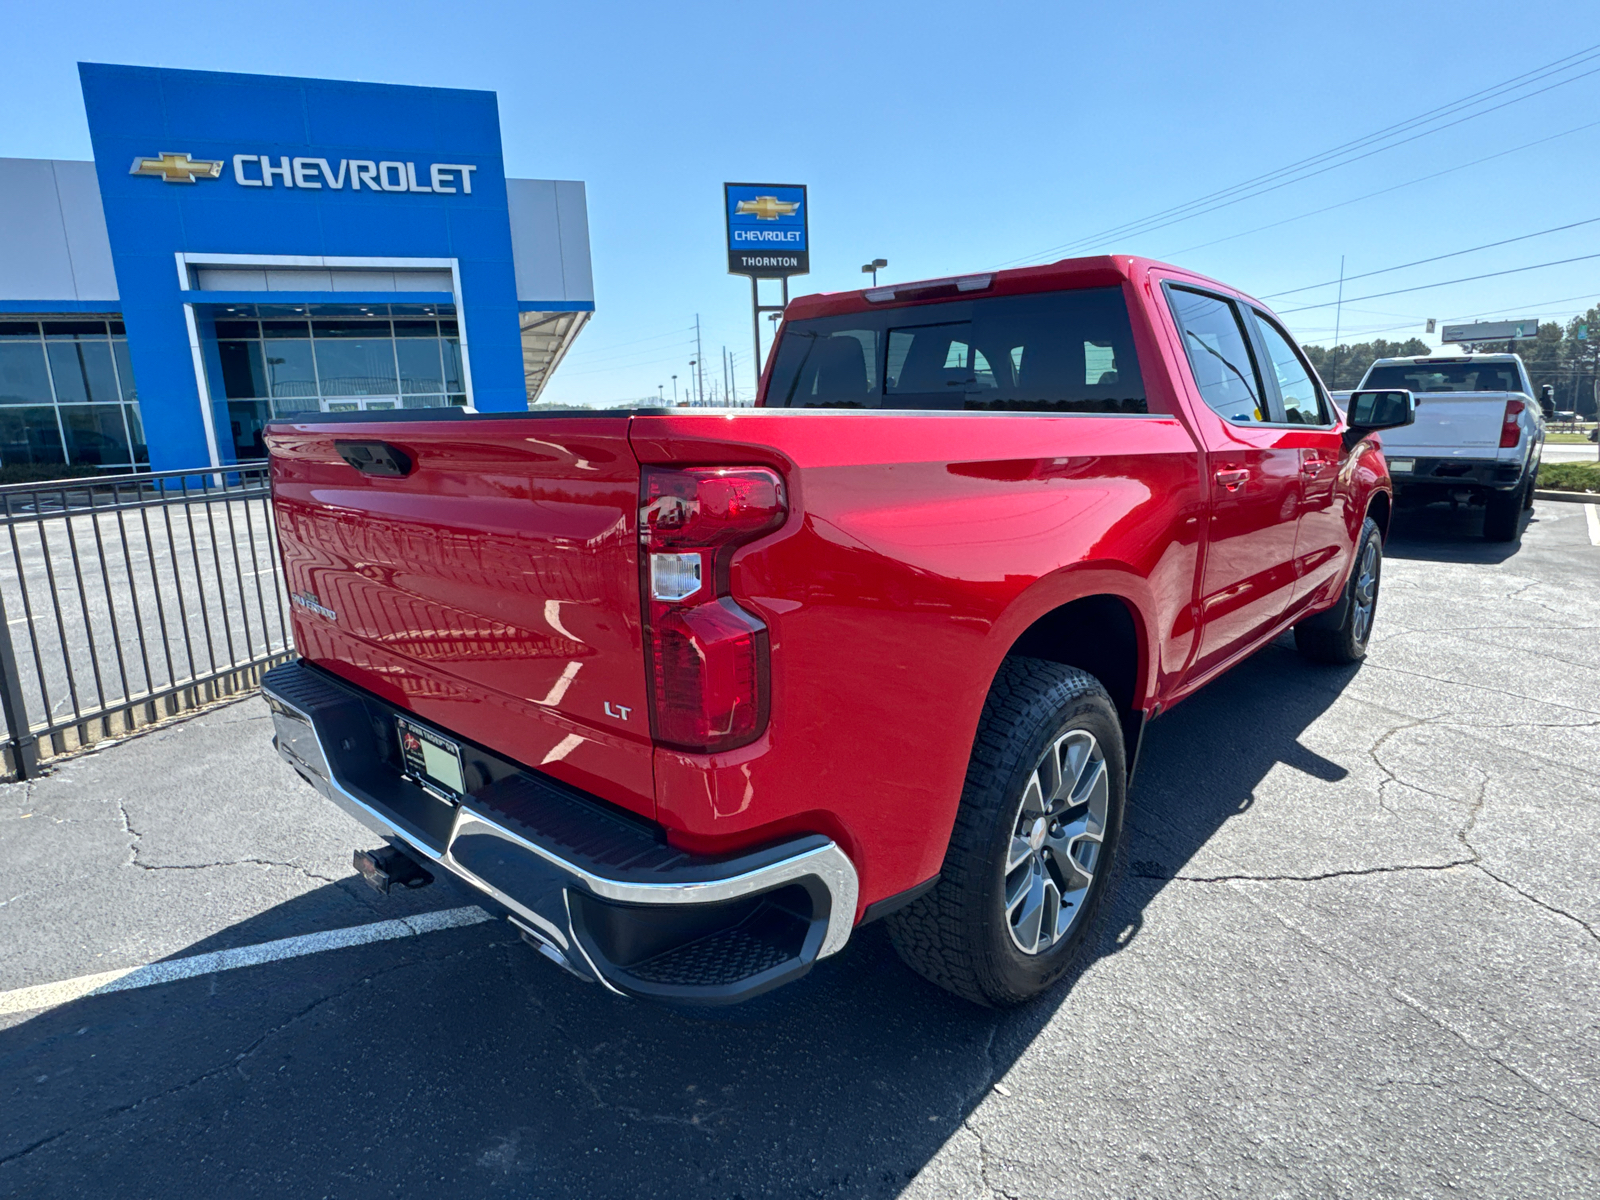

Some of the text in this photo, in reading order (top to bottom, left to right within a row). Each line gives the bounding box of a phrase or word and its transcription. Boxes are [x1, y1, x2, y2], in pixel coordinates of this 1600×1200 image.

[233, 154, 477, 194] CHEVROLET
[734, 230, 801, 242] CHEVROLET
[741, 257, 798, 267] THORNTON
[604, 701, 632, 720] LT
